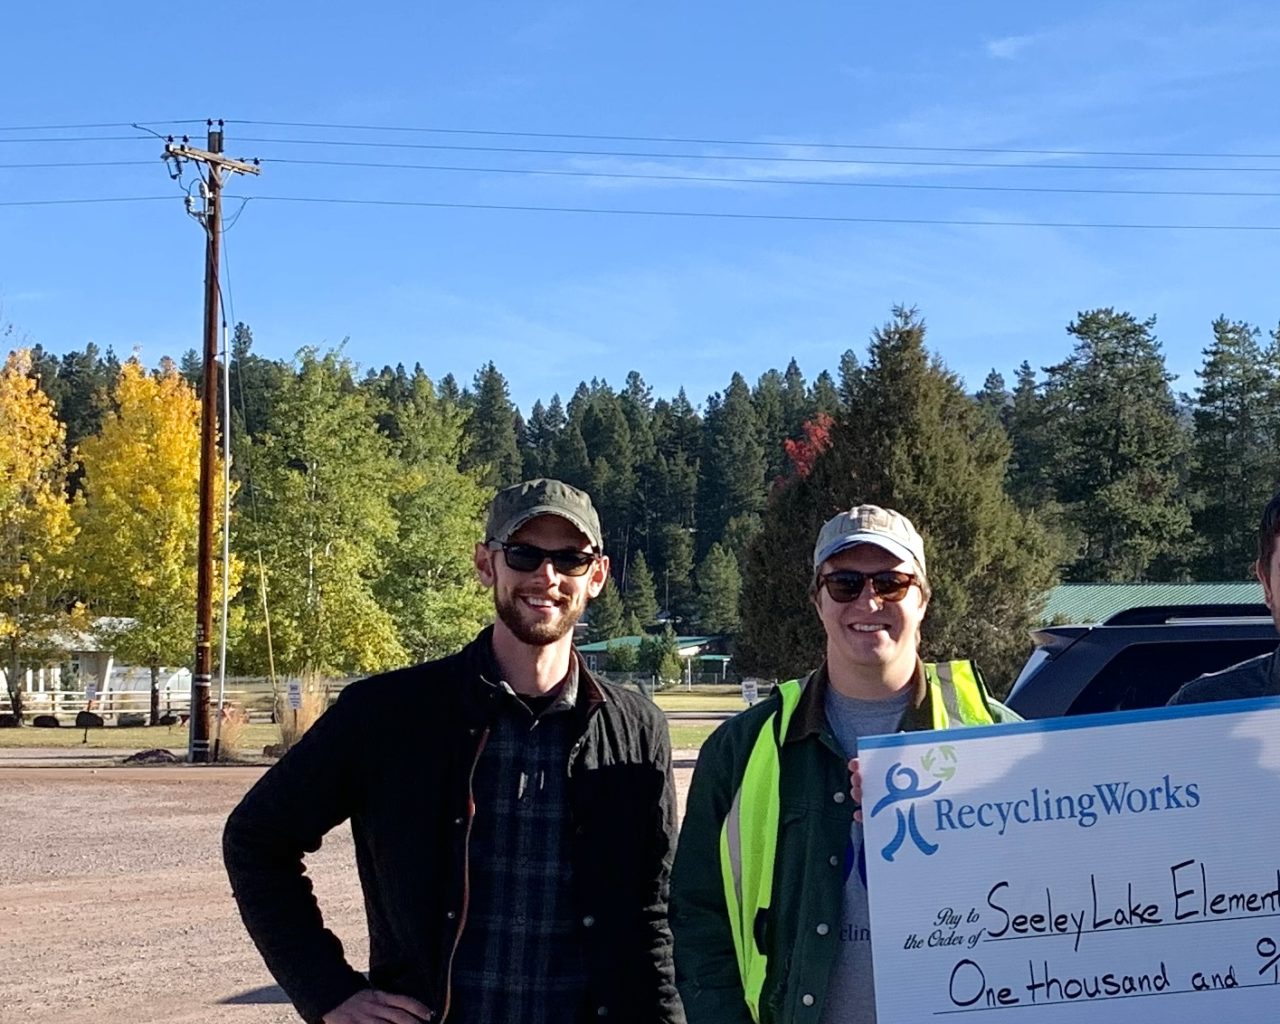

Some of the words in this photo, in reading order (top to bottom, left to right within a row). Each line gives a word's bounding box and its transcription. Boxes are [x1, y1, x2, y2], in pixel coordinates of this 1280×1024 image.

[934, 775, 1201, 835] RecyclingWorks
[933, 907, 962, 929] Pay
[966, 907, 980, 923] to
[986, 881, 1085, 952] Seeley
[1091, 874, 1163, 929] Lake
[903, 934, 924, 950] the
[927, 929, 964, 948] Order
[967, 927, 987, 949] of
[950, 958, 1019, 1007] One
[1026, 959, 1170, 1003] thousand
[1191, 965, 1239, 990] and
